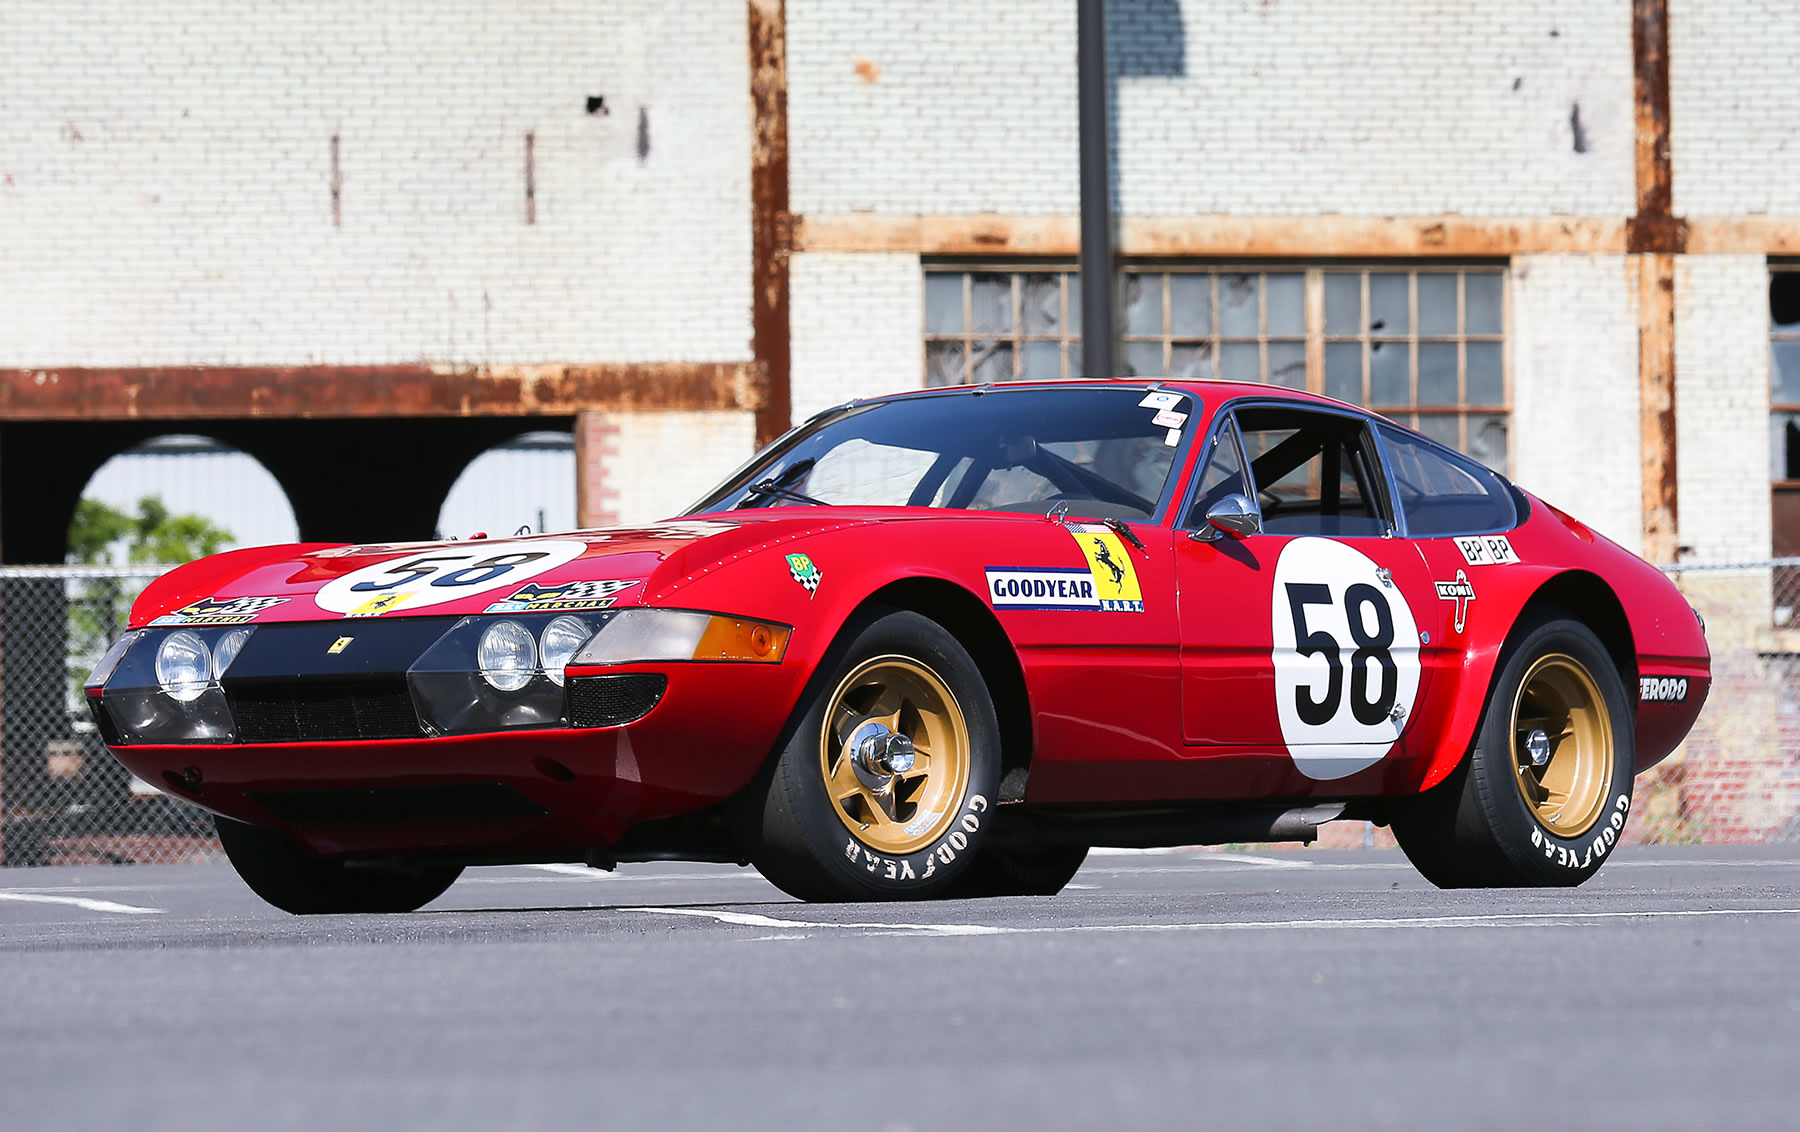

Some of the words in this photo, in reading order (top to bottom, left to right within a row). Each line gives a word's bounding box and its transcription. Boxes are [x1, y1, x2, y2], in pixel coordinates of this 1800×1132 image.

[1461, 540, 1483, 561] BP
[1487, 539, 1509, 560] BP
[350, 552, 550, 591] 58
[791, 556, 810, 571] BP
[994, 579, 1093, 598] GOODYEAR
[1438, 585, 1471, 596] KONI
[525, 600, 606, 610] MARCHAL
[1285, 583, 1398, 726] 58
